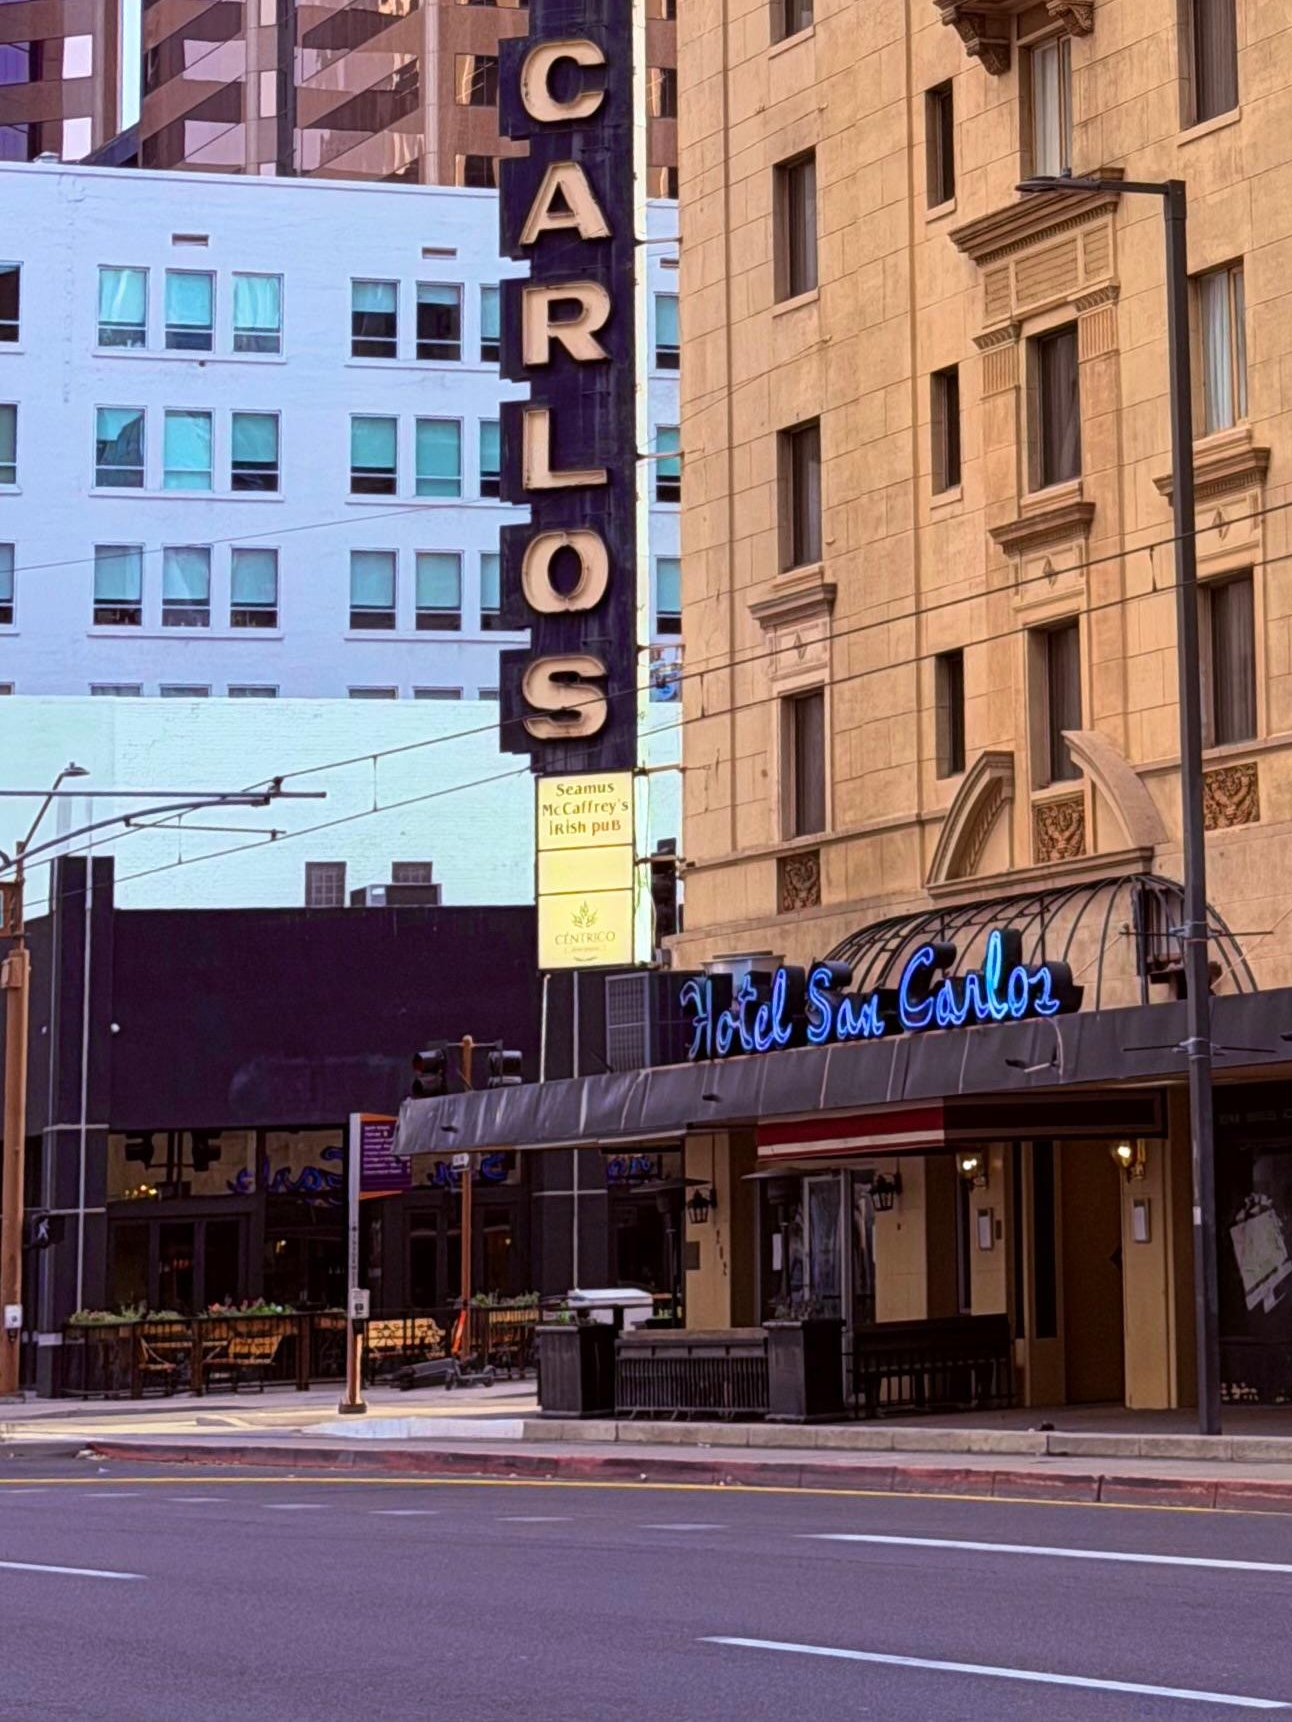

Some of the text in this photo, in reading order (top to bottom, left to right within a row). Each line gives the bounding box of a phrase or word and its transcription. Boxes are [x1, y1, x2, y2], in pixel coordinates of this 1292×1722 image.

[518, 37, 612, 741] CARLOS
[542, 799, 629, 816] McCaffrey's
[556, 782, 615, 797] Seamus
[680, 927, 1062, 1060] Hotel San Carlos
